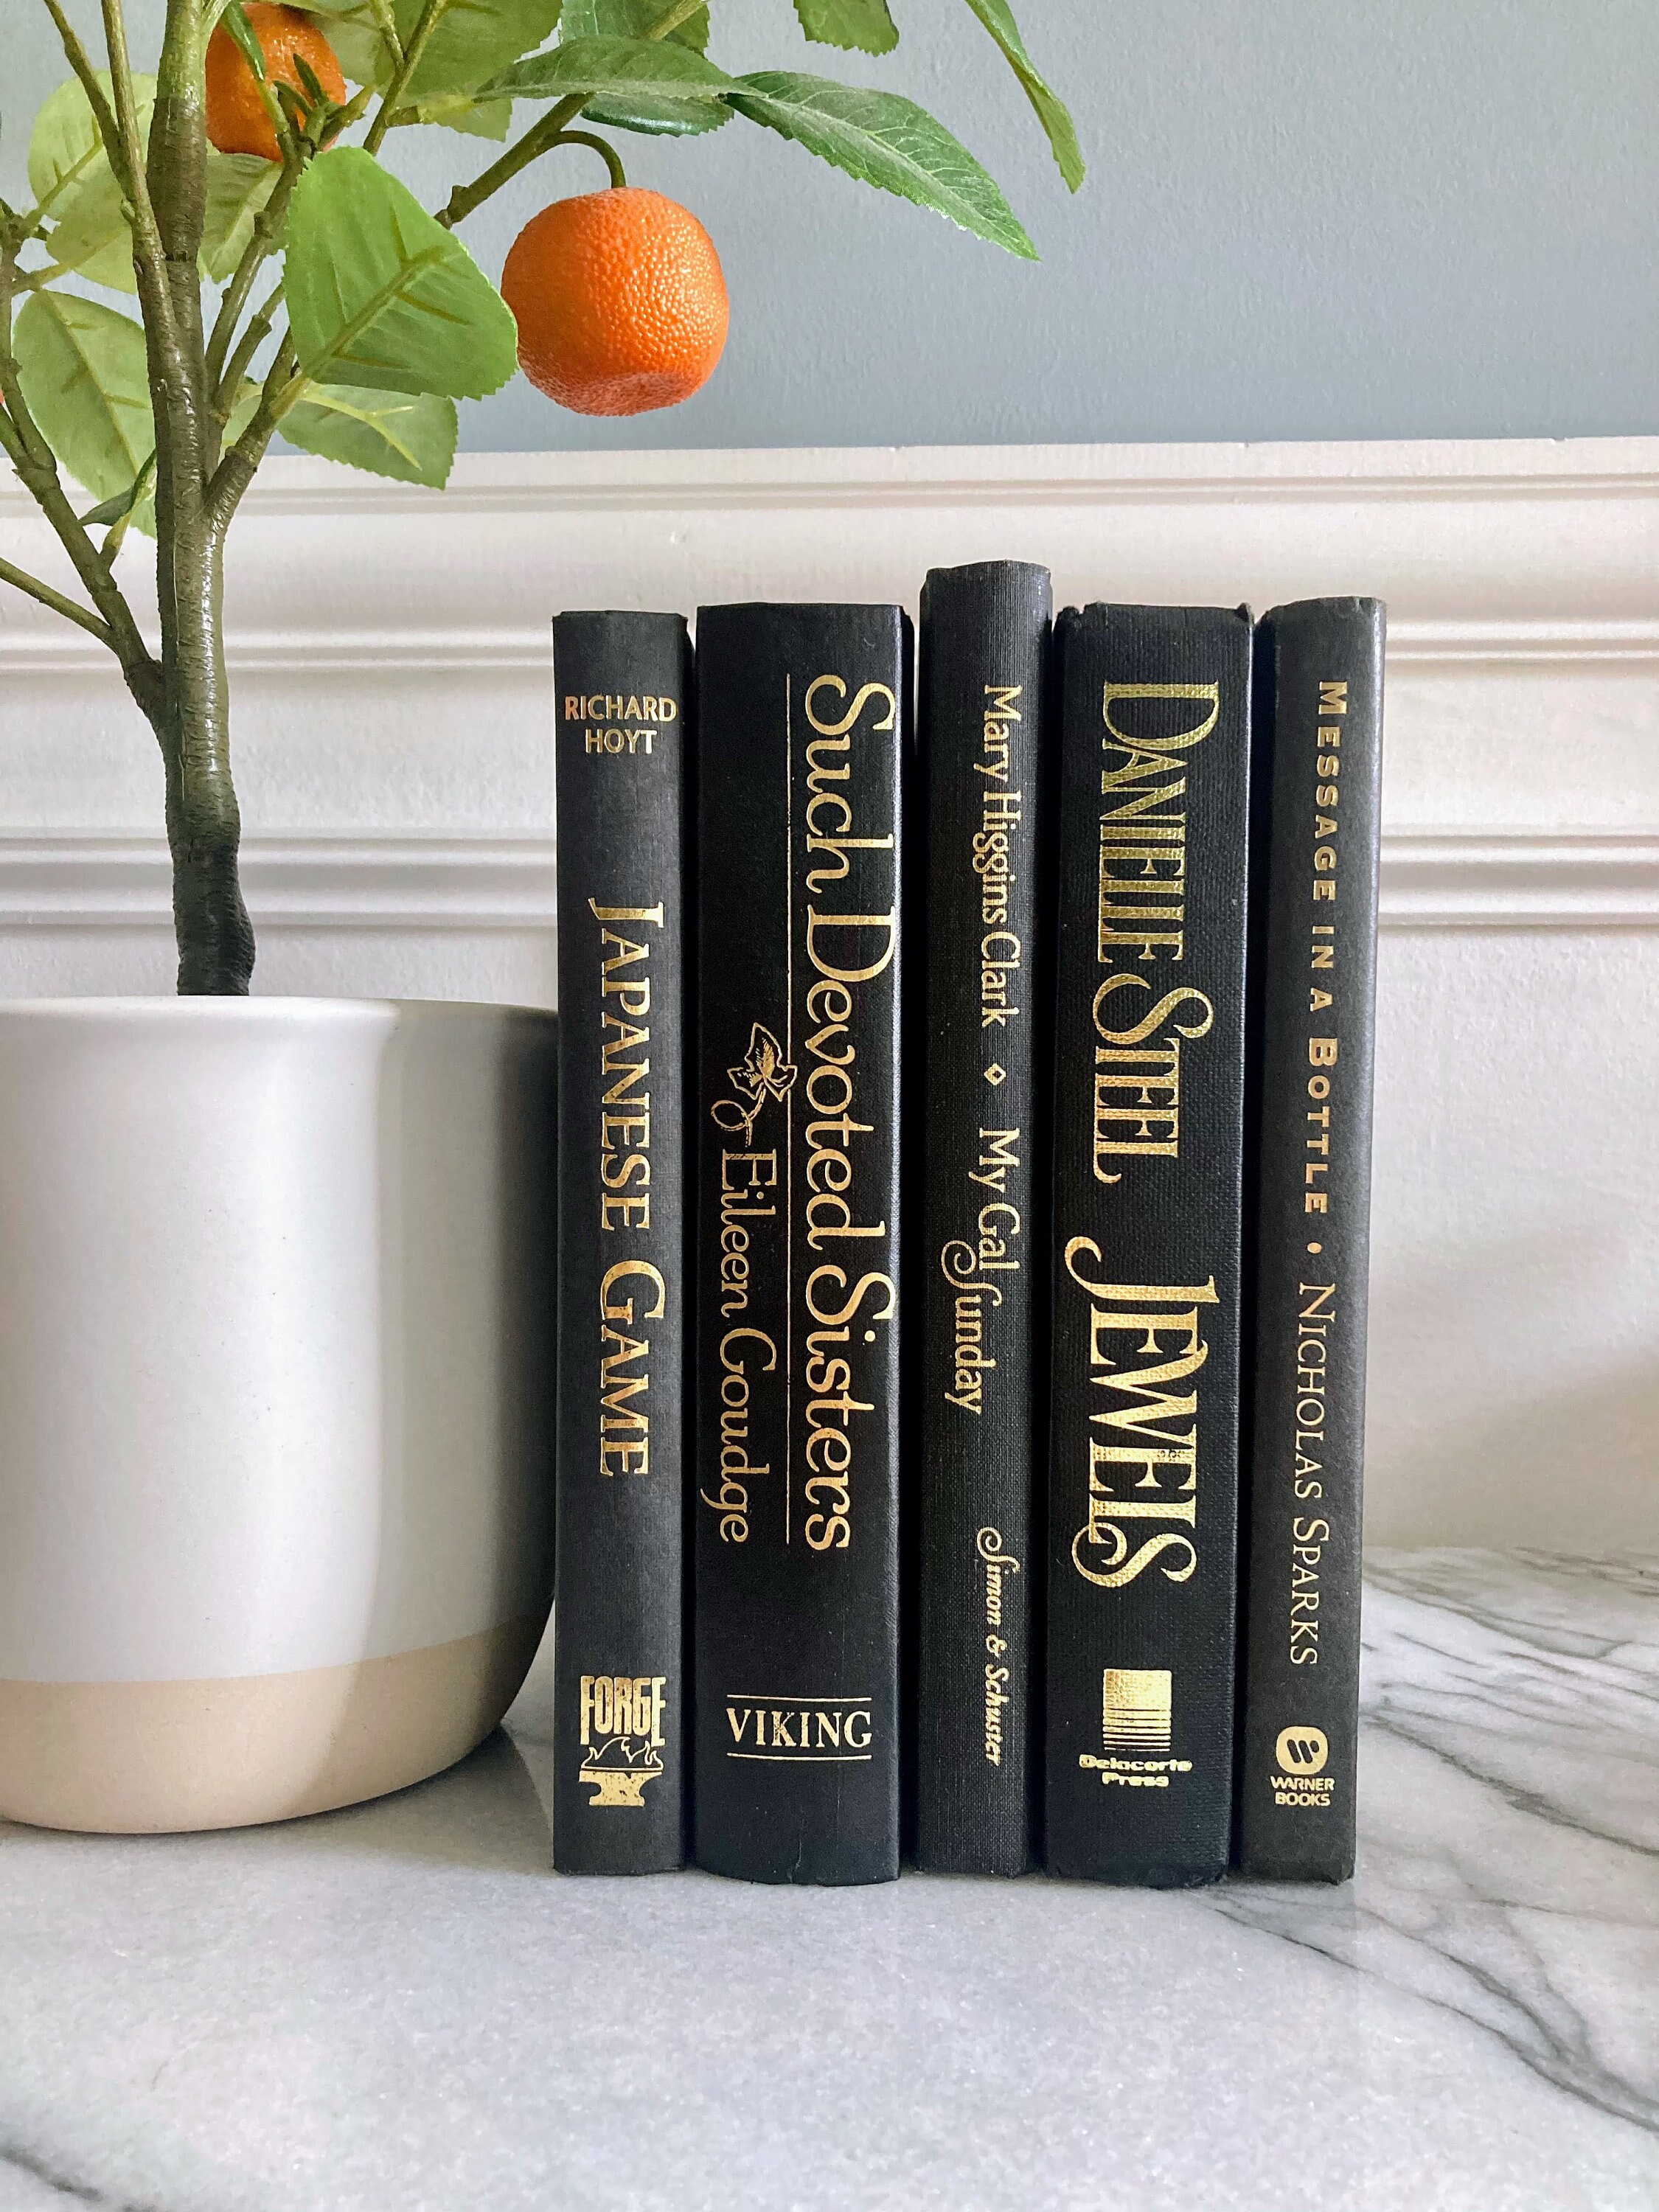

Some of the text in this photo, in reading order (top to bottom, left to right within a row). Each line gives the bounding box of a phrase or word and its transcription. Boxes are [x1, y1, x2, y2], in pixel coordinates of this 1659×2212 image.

[565, 694, 678, 723] RICHARD
[585, 728, 657, 754] HOYT
[1092, 680, 1220, 1184] DANIELLE STEEL
[805, 674, 897, 1551] Such Devoted Sisters
[941, 684, 1023, 1415] Mary Higgins Clark My Gal Sunday
[588, 897, 666, 1477] JAPANESE GAME
[1290, 680, 1348, 1666] MESSAGE IN A BOTTLE NICHOLAS SPARKS
[700, 1147, 777, 1543] Eileen Goudge
[1064, 1236, 1221, 1588] JEWELS
[580, 1675, 667, 1747] FORGE
[977, 1526, 1020, 1767] Simon & Schuster
[726, 1707, 873, 1748] VIKING
[1079, 1754, 1193, 1773] Delacorte
[1102, 1772, 1169, 1787] Press
[1270, 1775, 1335, 1792] WARNER
[1275, 1792, 1332, 1807] BOOKS
